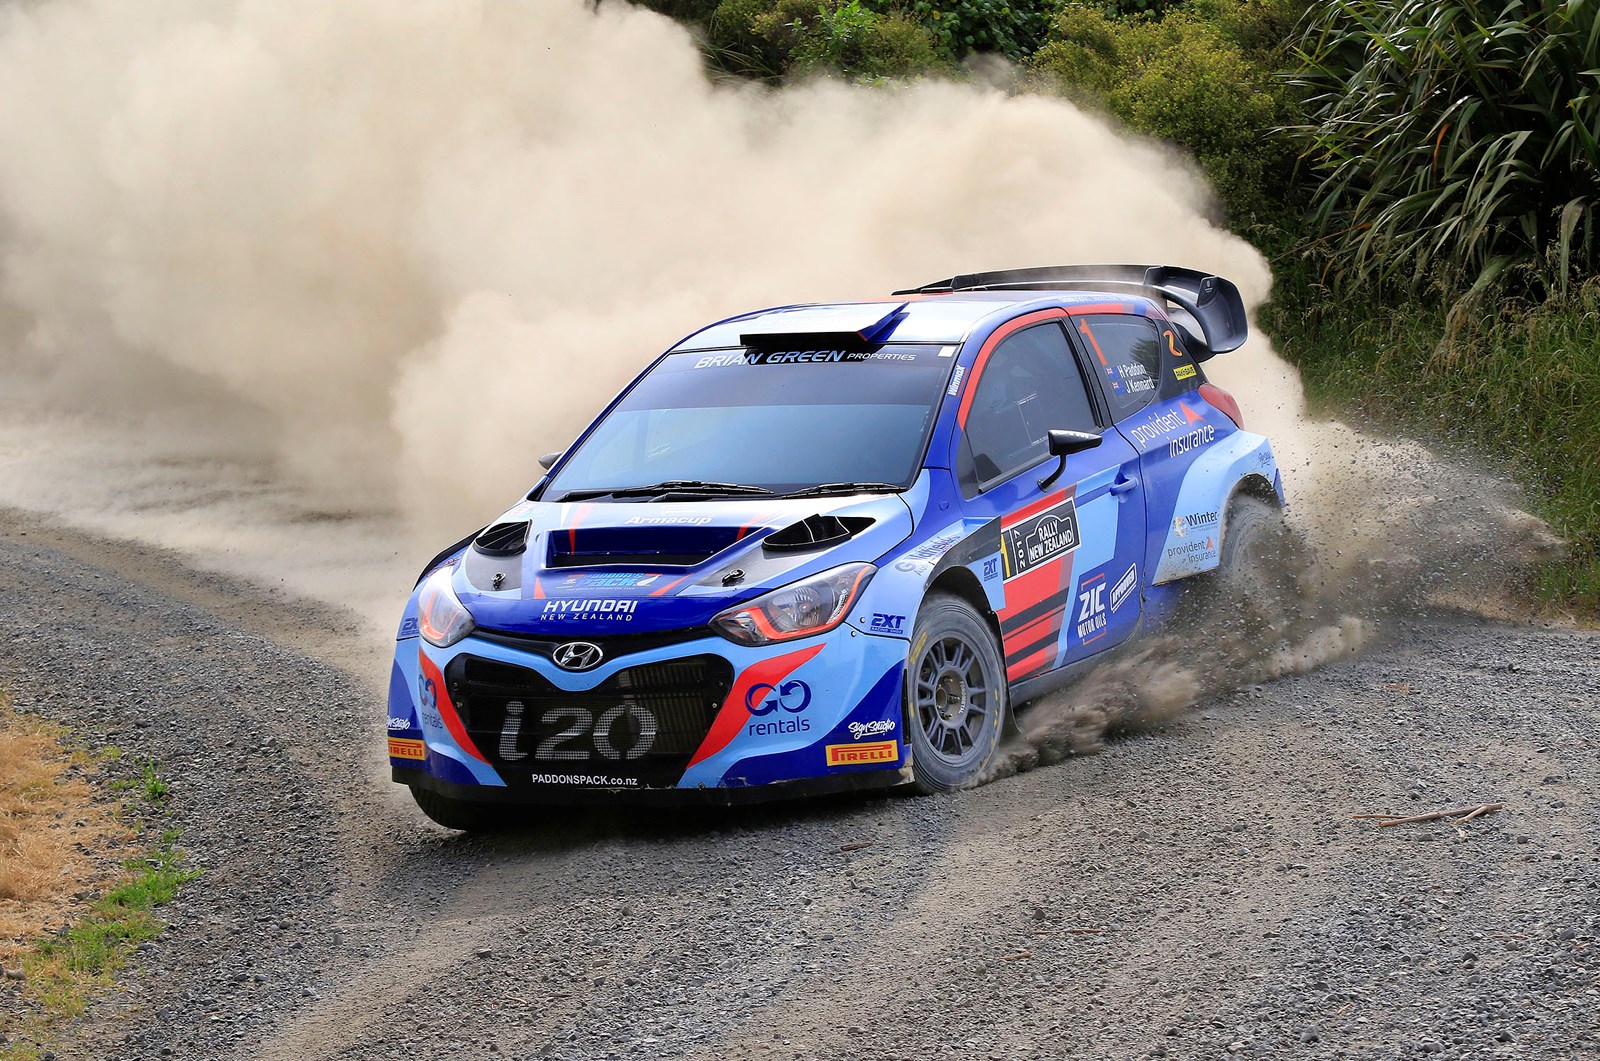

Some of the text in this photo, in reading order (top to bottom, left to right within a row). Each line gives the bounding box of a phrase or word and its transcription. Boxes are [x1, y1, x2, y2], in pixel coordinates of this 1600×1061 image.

[1079, 318, 1107, 366] 1
[694, 350, 917, 369] BRIAN GREEN PROPERTIES
[1117, 362, 1147, 378] H Paddon
[1129, 376, 1155, 393] Kennard
[1130, 408, 1187, 448] provident
[1166, 423, 1215, 459] insurance
[624, 516, 713, 526] Armacup
[1185, 511, 1218, 527] Winter
[1038, 519, 1059, 542] RALLY
[1013, 529, 1026, 569] 2017
[1029, 529, 1073, 561] NEW ZEALAND
[1167, 540, 1206, 559] provident
[1187, 549, 1217, 564] insurance
[543, 599, 639, 614] HYUNDAI
[1078, 582, 1107, 623] ZIC
[573, 613, 633, 622] ZEALAND
[1077, 612, 1107, 639] MOTOR OILS
[745, 679, 812, 717] GO
[499, 700, 658, 761] i20
[749, 716, 811, 736] rentals
[831, 743, 893, 762] PIRELLI
[531, 773, 638, 786] PADDONSPACK.co.nz
